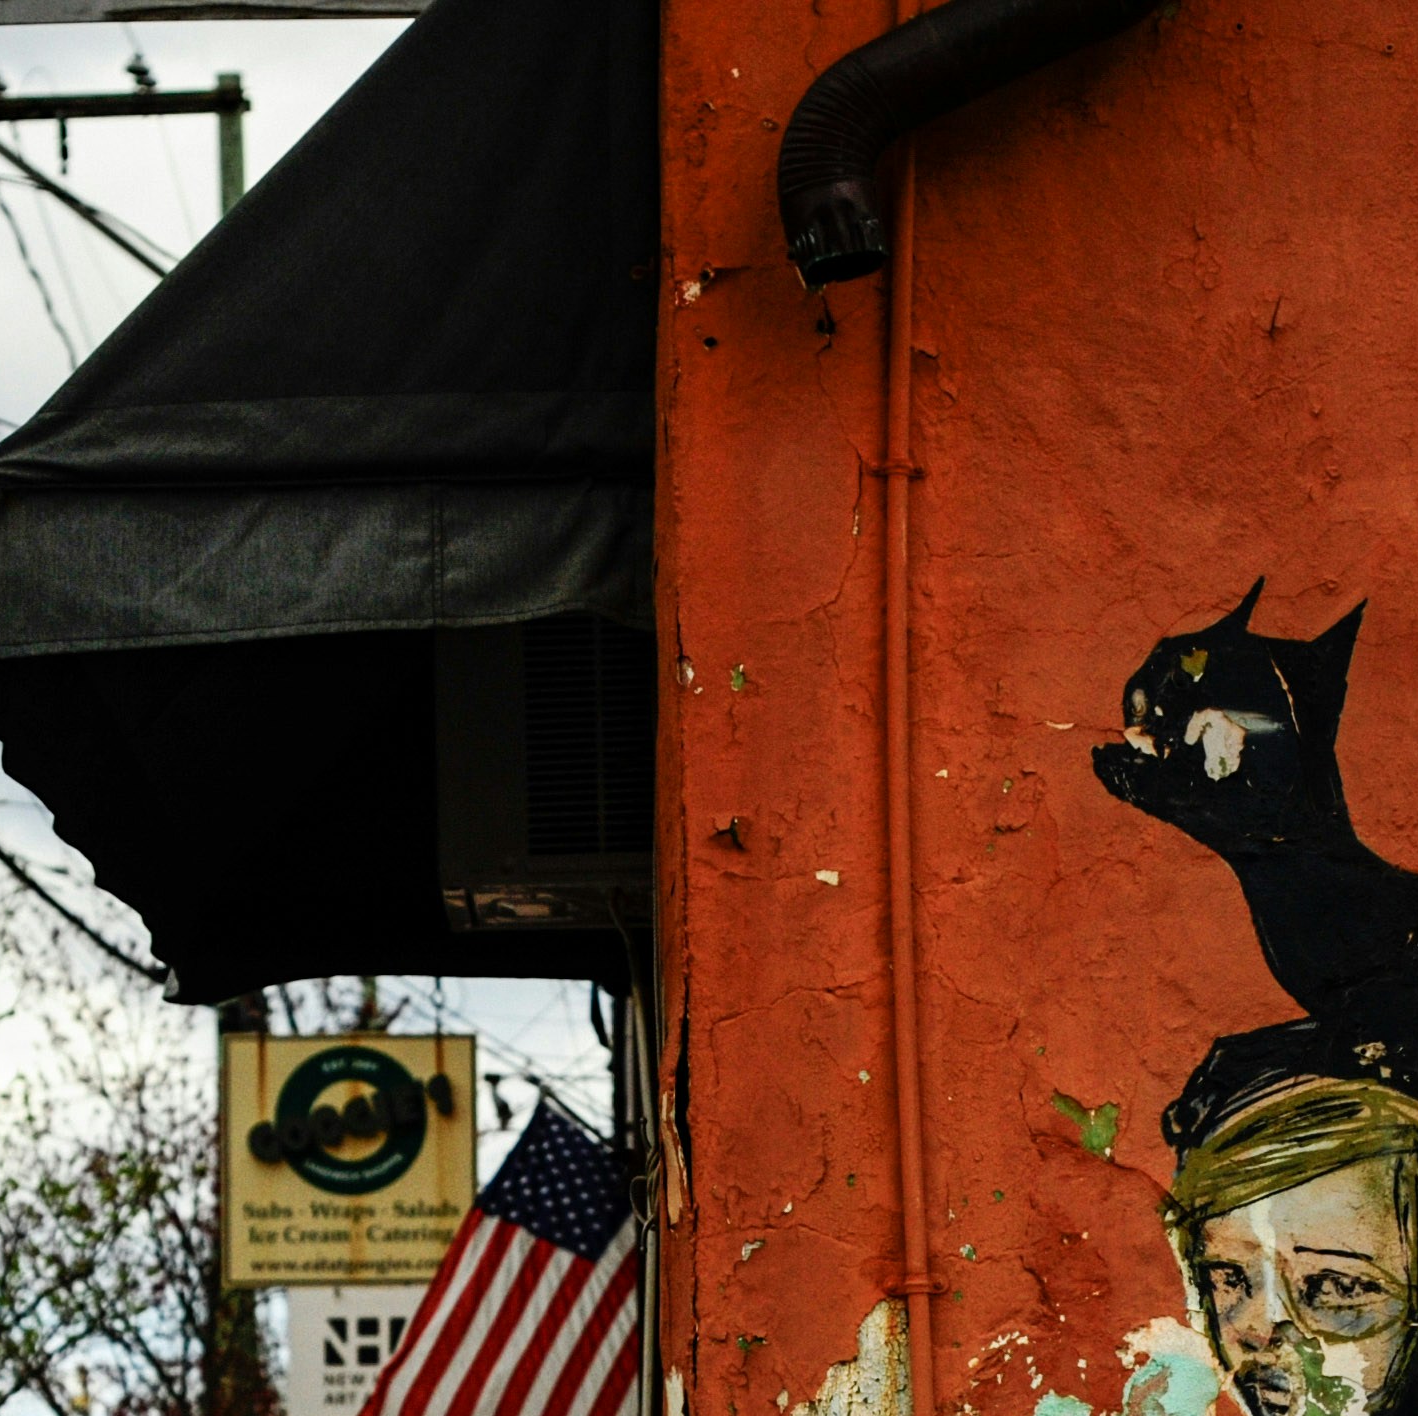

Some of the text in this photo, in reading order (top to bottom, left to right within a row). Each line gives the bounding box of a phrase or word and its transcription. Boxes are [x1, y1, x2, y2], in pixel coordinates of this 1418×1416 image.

[242, 1200, 460, 1223] Subs Wraps Salads
[248, 1225, 455, 1244] Ice Cream Catering
[324, 1374, 365, 1385] NEW
